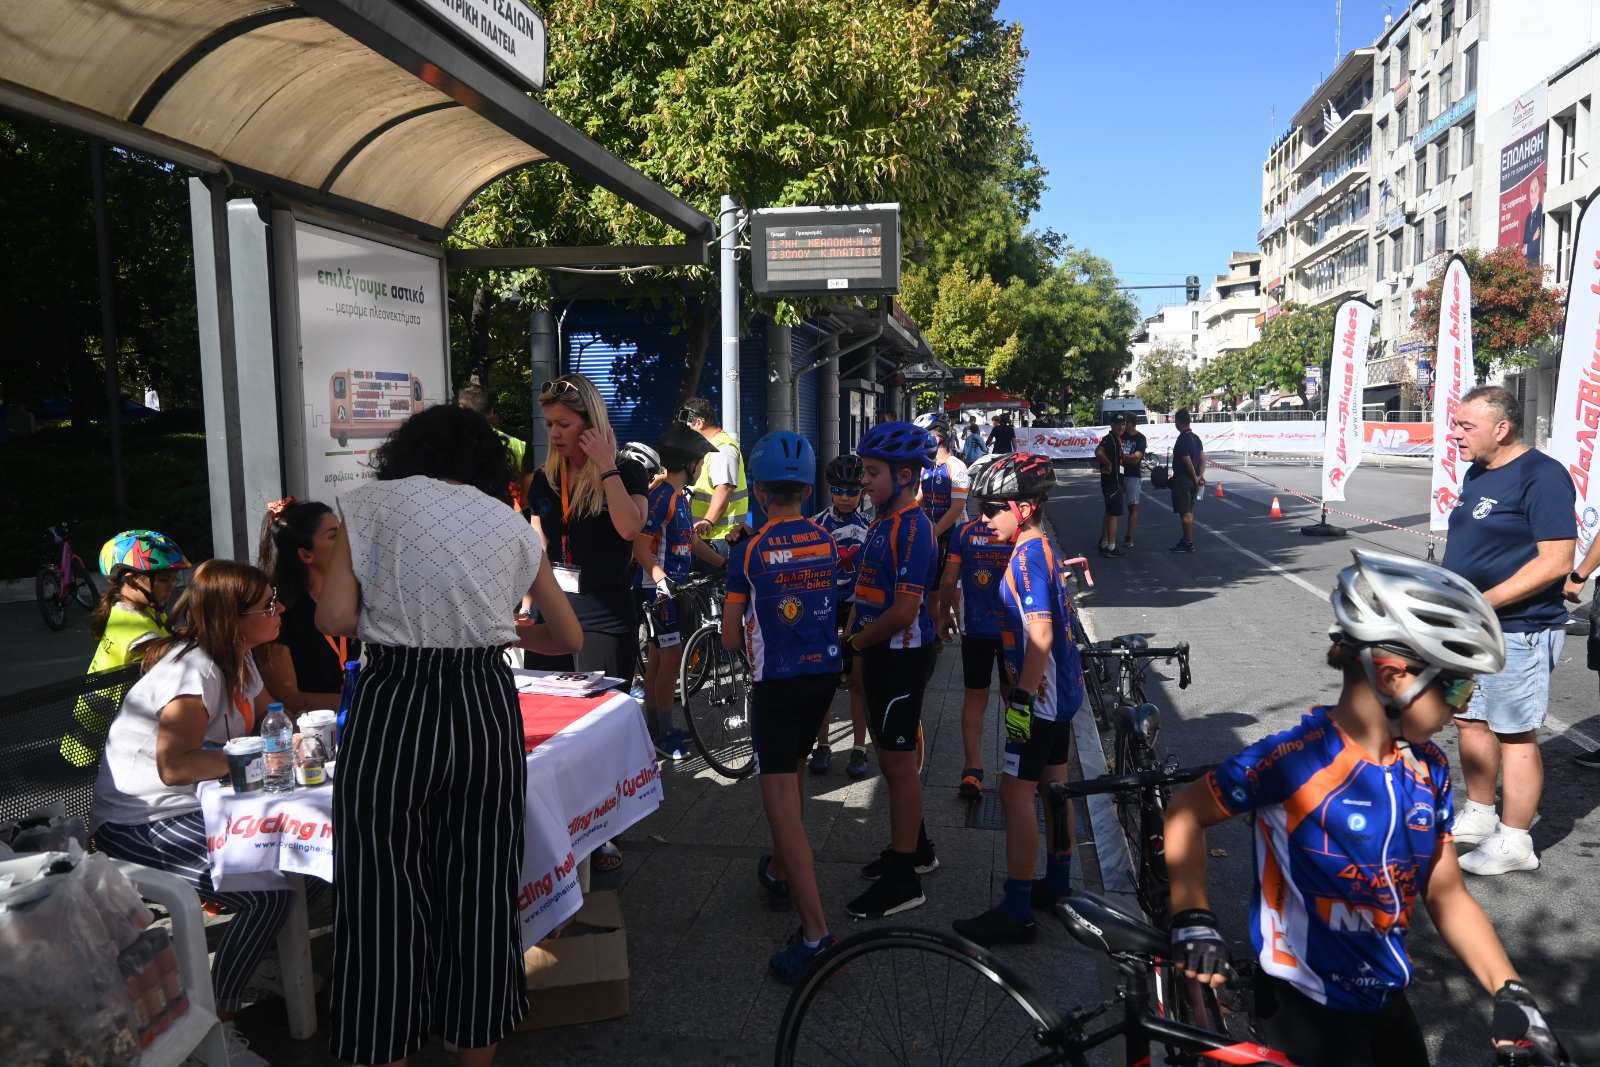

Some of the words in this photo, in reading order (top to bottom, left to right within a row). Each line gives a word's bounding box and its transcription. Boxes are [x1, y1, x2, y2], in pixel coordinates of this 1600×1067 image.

[480, 14, 516, 57] ΠΛΑΤΕΙΑ
[1501, 131, 1545, 172] ΕΠΩΛΗΘΗ
[317, 267, 388, 300] επιλέγουμε
[390, 284, 425, 305] αστικό
[1342, 306, 1358, 359] bikes
[1047, 436, 1088, 448] Cycling
[1371, 428, 1410, 449] NP
[769, 550, 793, 565] NP
[231, 811, 317, 841] Cycling
